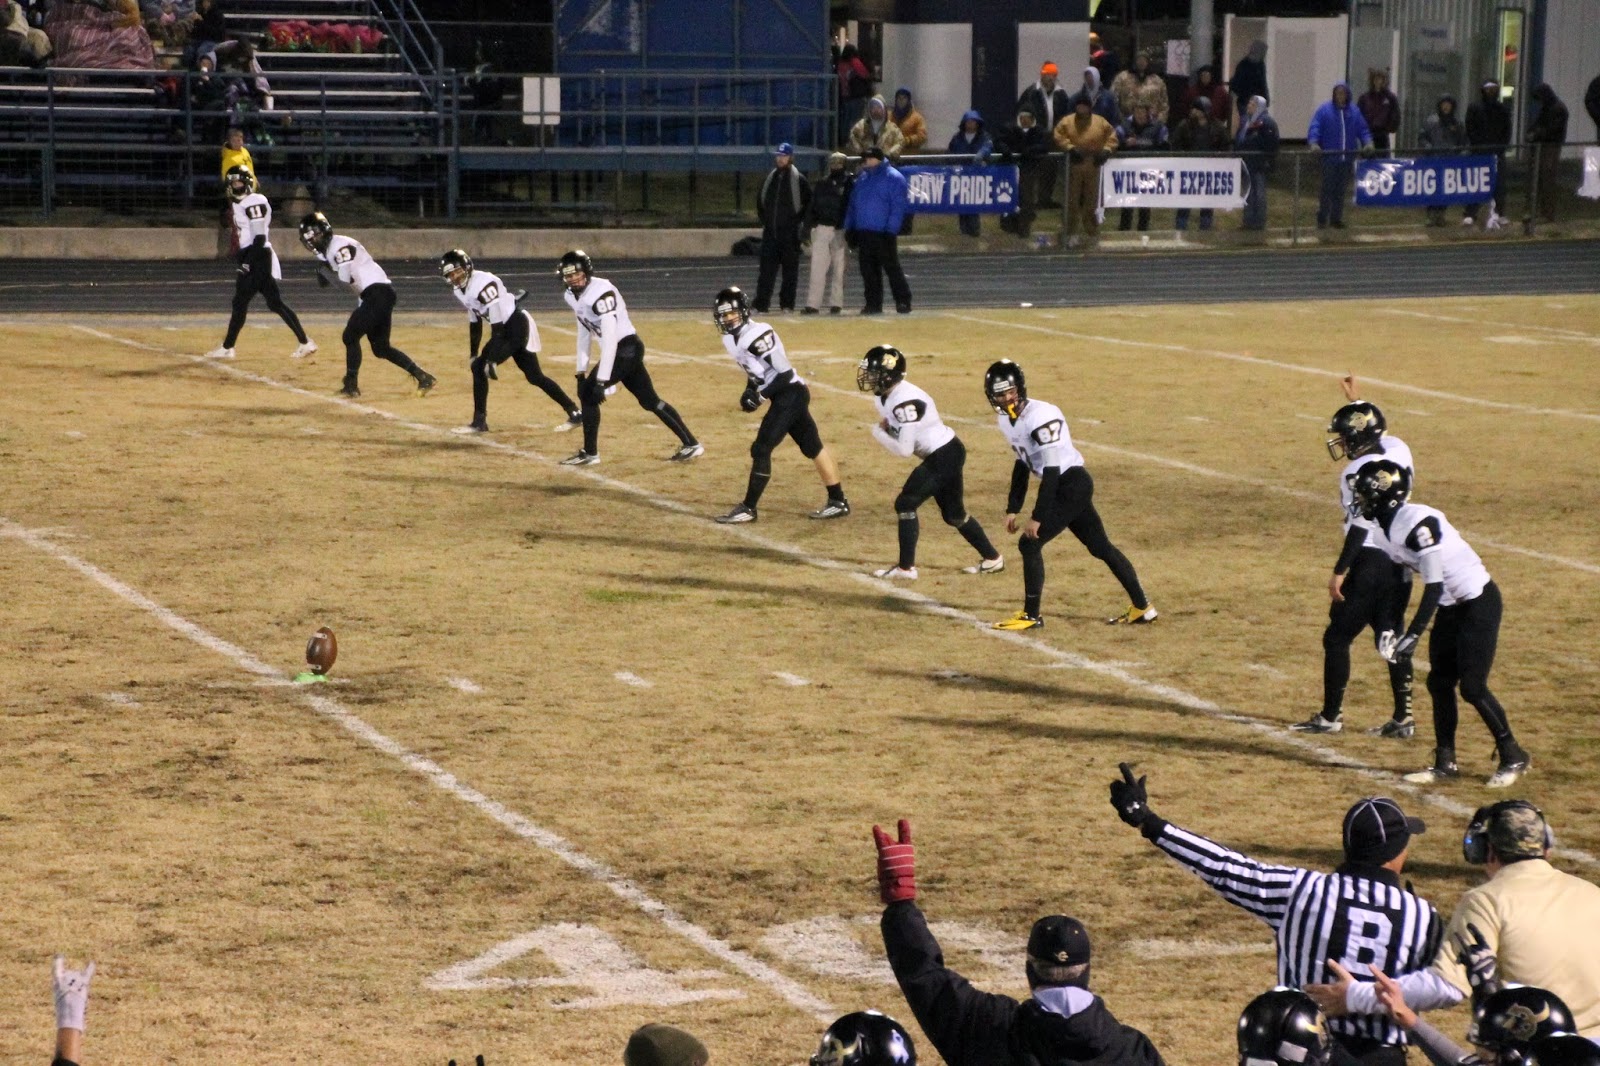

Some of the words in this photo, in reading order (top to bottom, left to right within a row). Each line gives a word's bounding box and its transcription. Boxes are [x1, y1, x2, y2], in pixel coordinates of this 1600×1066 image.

[908, 174, 945, 205] PAW
[949, 174, 994, 205] PRIDE
[1179, 170, 1235, 196] EXPRESS
[1366, 169, 1394, 196] GO
[1402, 168, 1437, 196] BIG
[1443, 166, 1491, 195] BLUE
[249, 205, 263, 219] 11
[480, 286, 498, 305] 10
[596, 295, 616, 313] 80
[1037, 420, 1062, 443] 87
[1340, 905, 1394, 977] B
